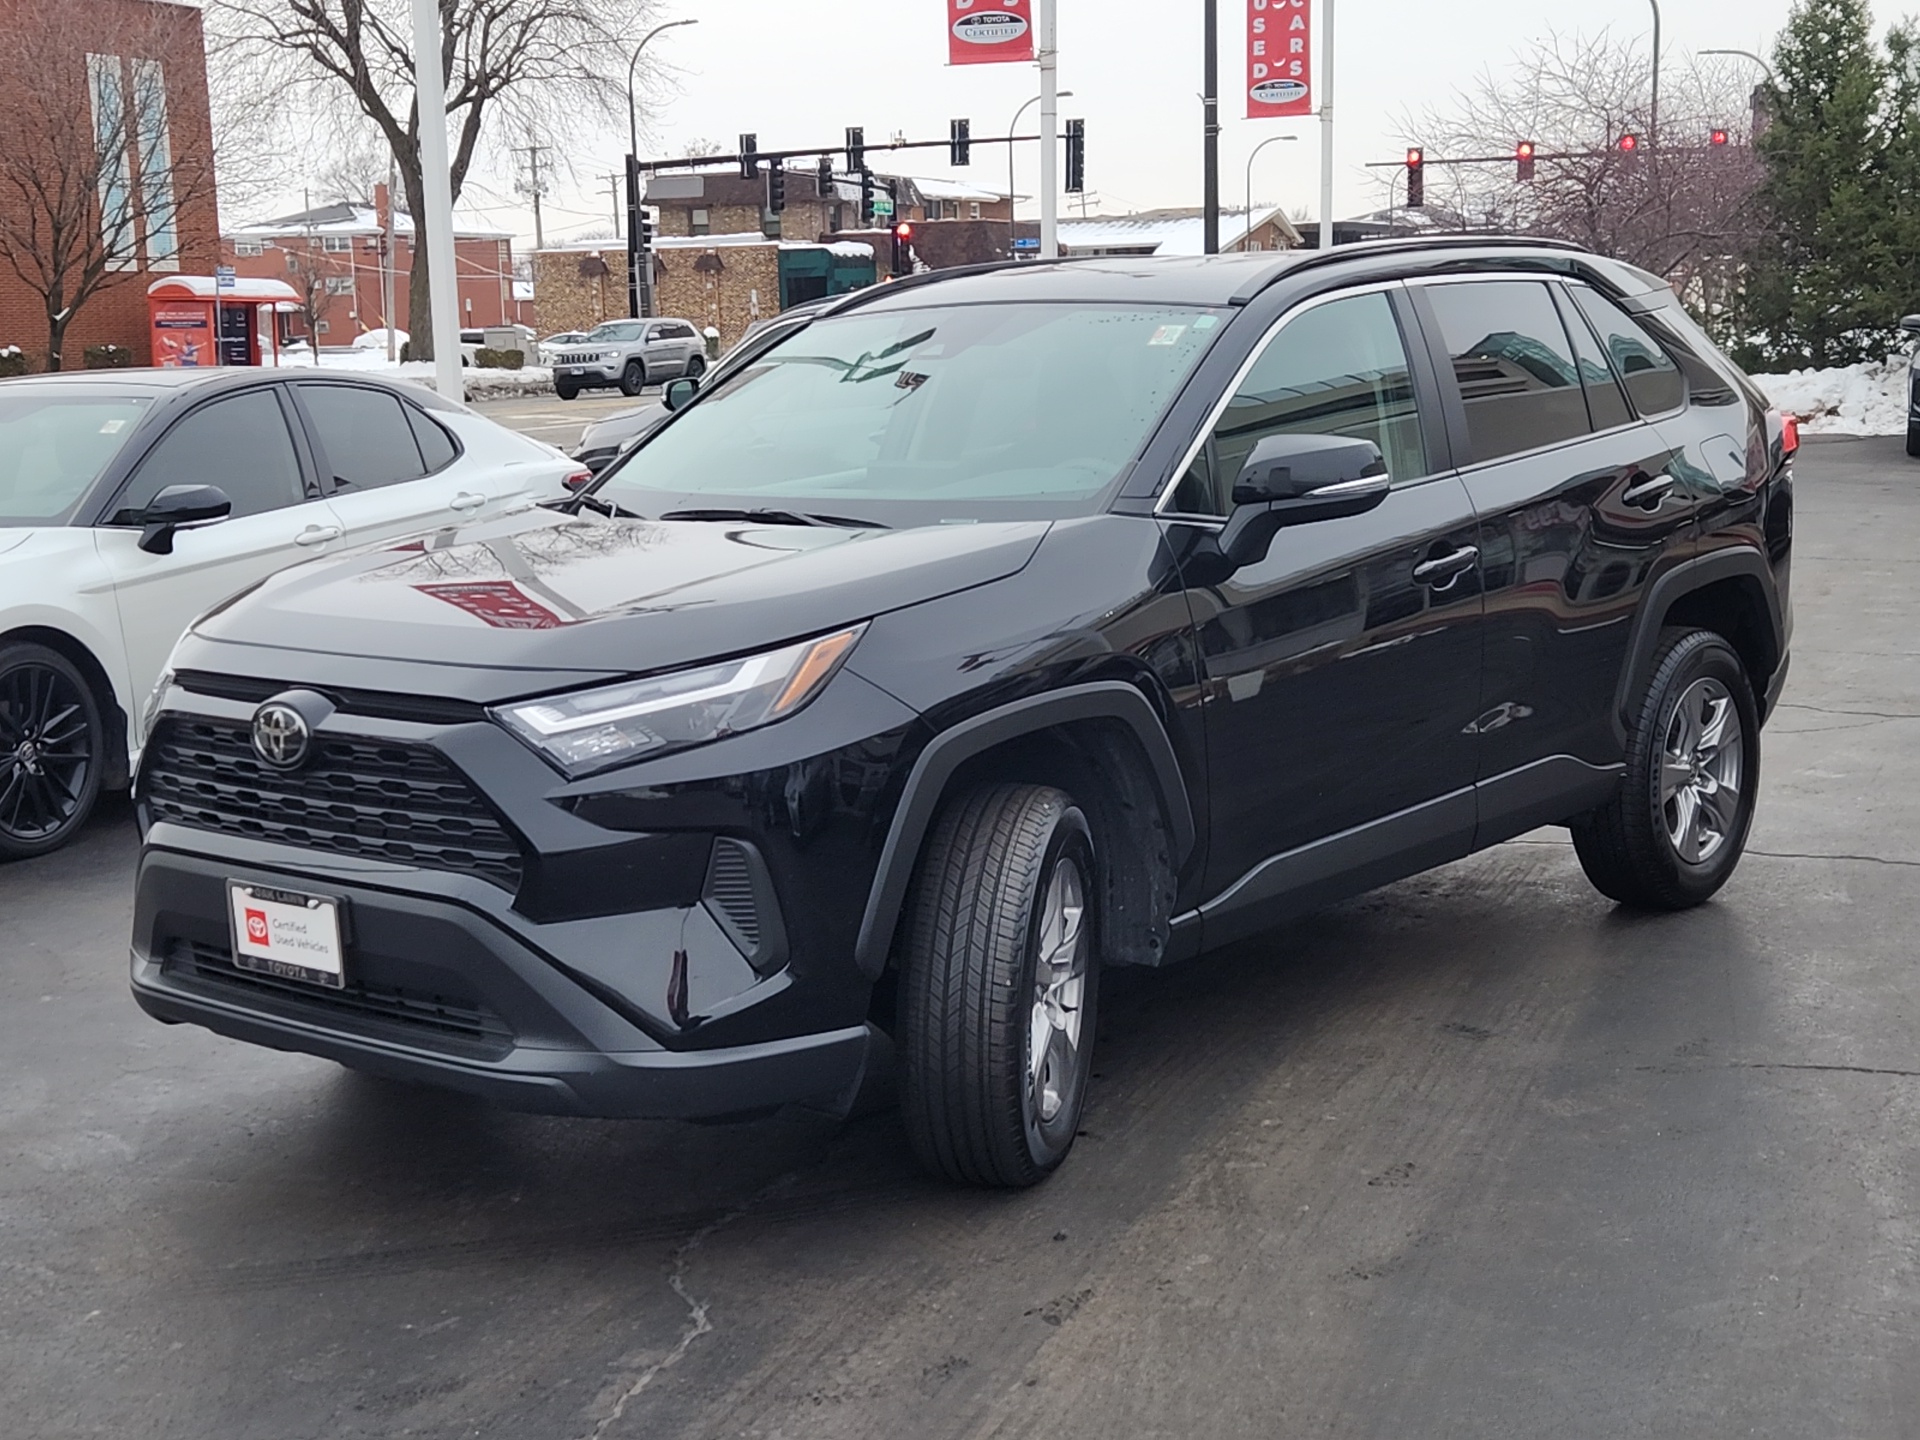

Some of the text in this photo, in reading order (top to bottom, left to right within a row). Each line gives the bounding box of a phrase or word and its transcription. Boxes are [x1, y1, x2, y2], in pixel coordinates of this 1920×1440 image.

[983, 16, 1010, 24] TOYOTA
[1253, 0, 1268, 79] USED
[272, 918, 307, 934] Certified
[273, 933, 329, 954] Used Vehicles
[267, 960, 308, 980] TOYOTA
